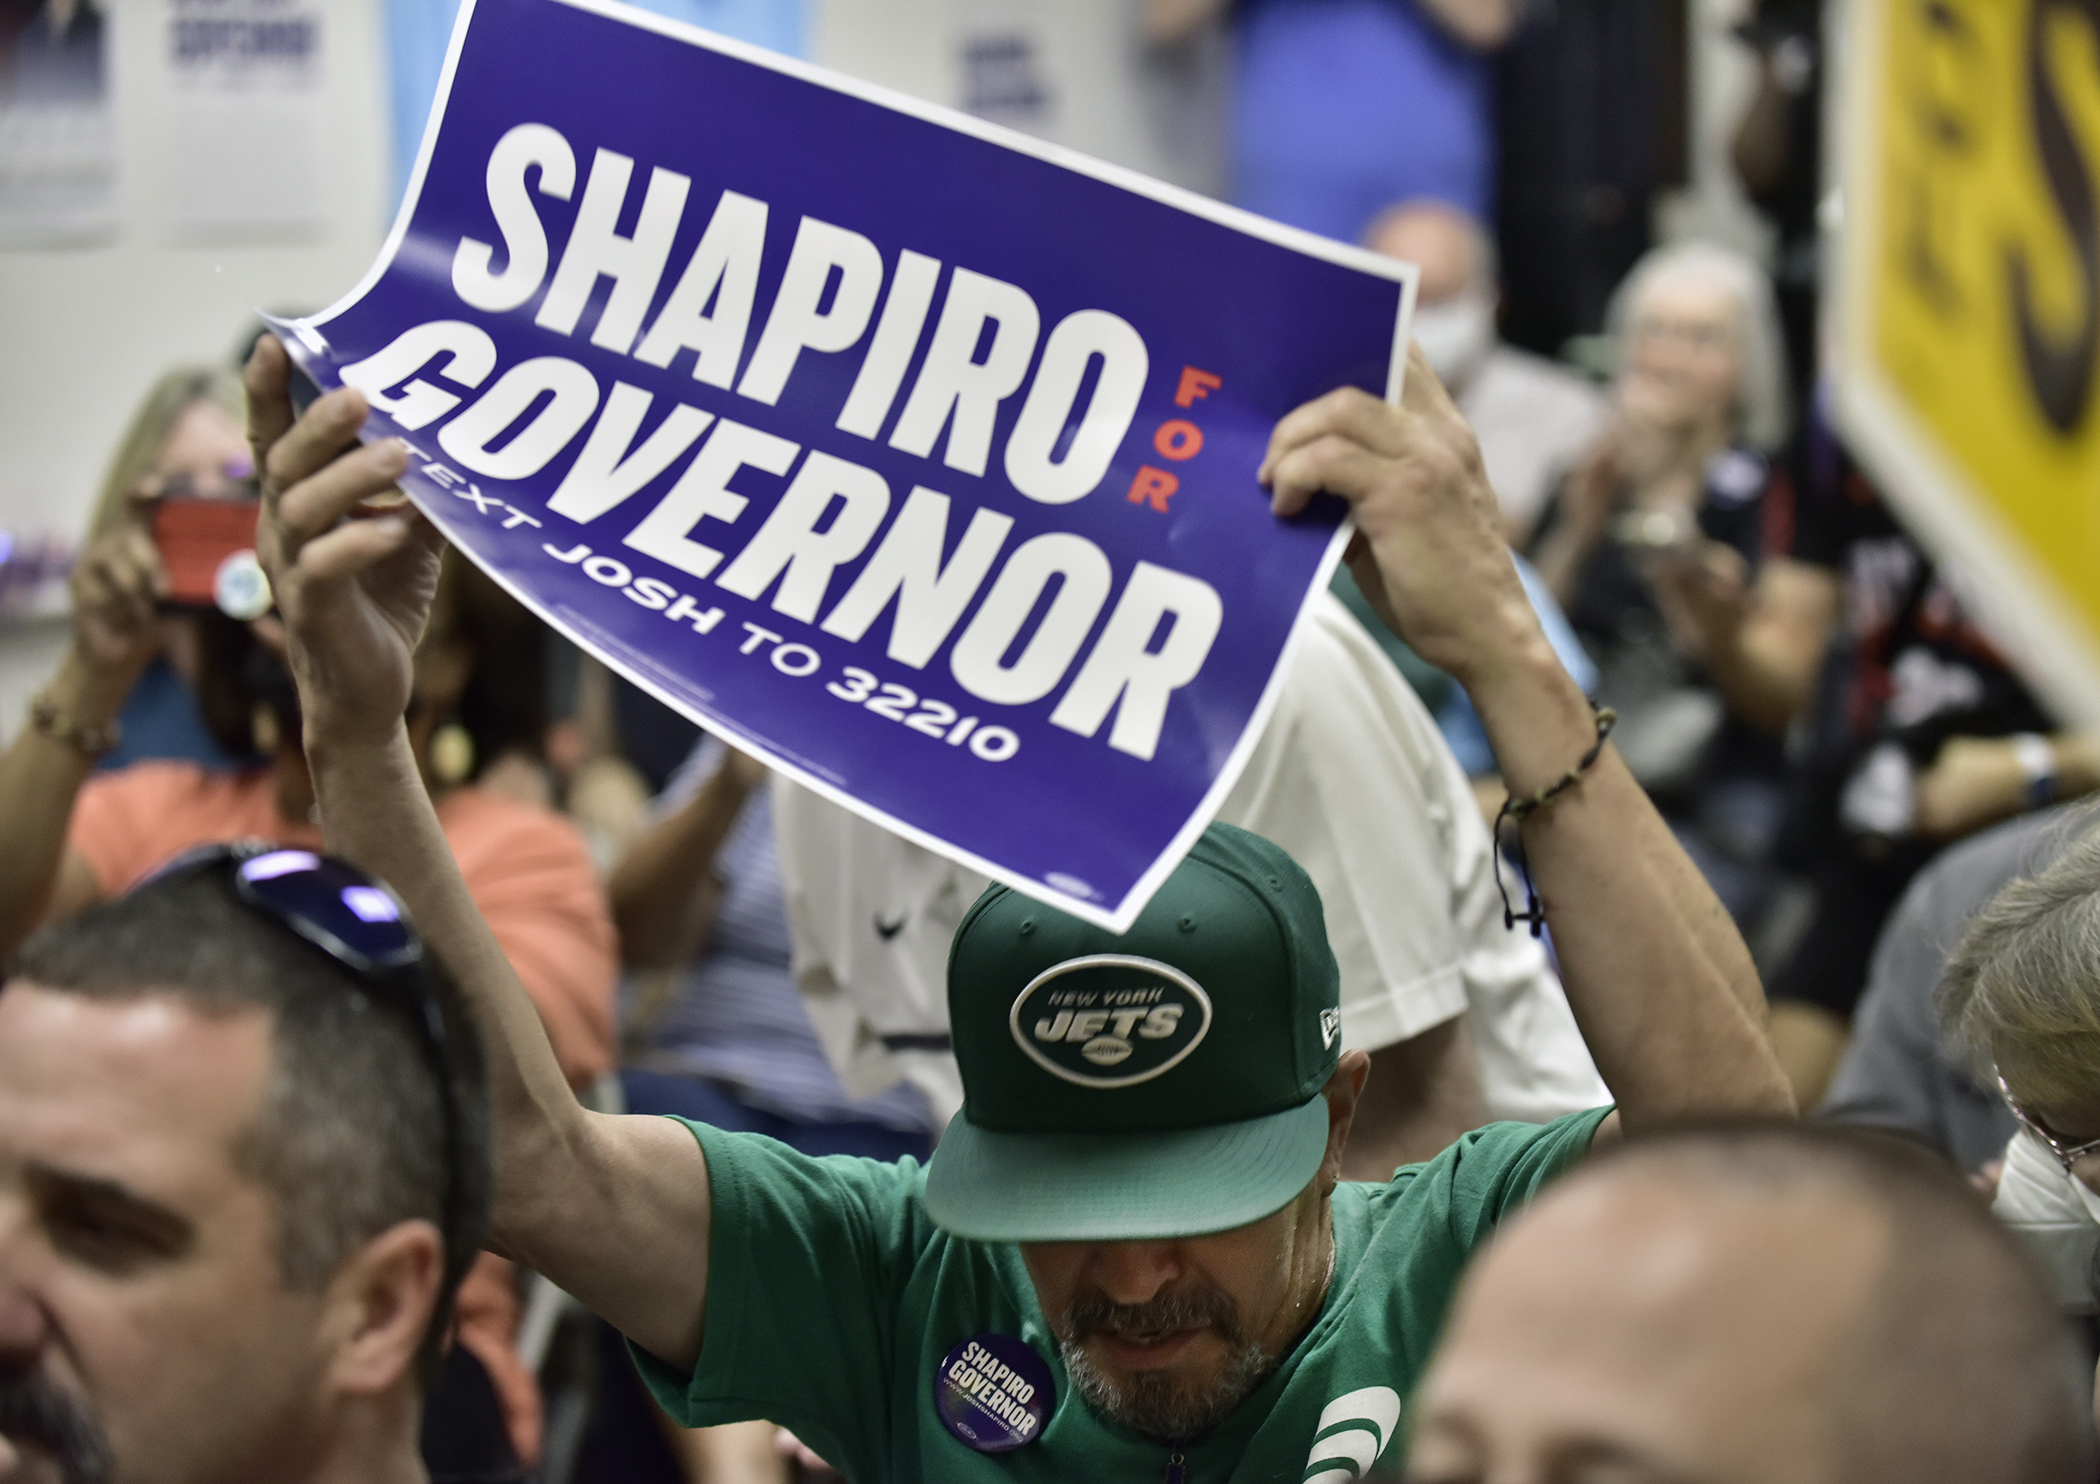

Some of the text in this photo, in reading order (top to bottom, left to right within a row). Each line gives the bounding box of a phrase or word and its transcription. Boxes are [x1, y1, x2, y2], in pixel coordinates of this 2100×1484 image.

[452, 122, 1149, 504] SHAPIRO
[1126, 366, 1222, 513] FOR
[338, 319, 1223, 762] GOVERNOR
[399, 436, 543, 530] TEXT
[542, 543, 725, 635] JOSH
[739, 621, 821, 677] TO
[826, 666, 1020, 762] 32210
[1034, 1003, 1185, 1042] JETS
[1048, 986, 1167, 1006] NEW YORK
[948, 1360, 1037, 1436] GOVERNOR
[962, 1341, 1035, 1404] SHAPIRO
